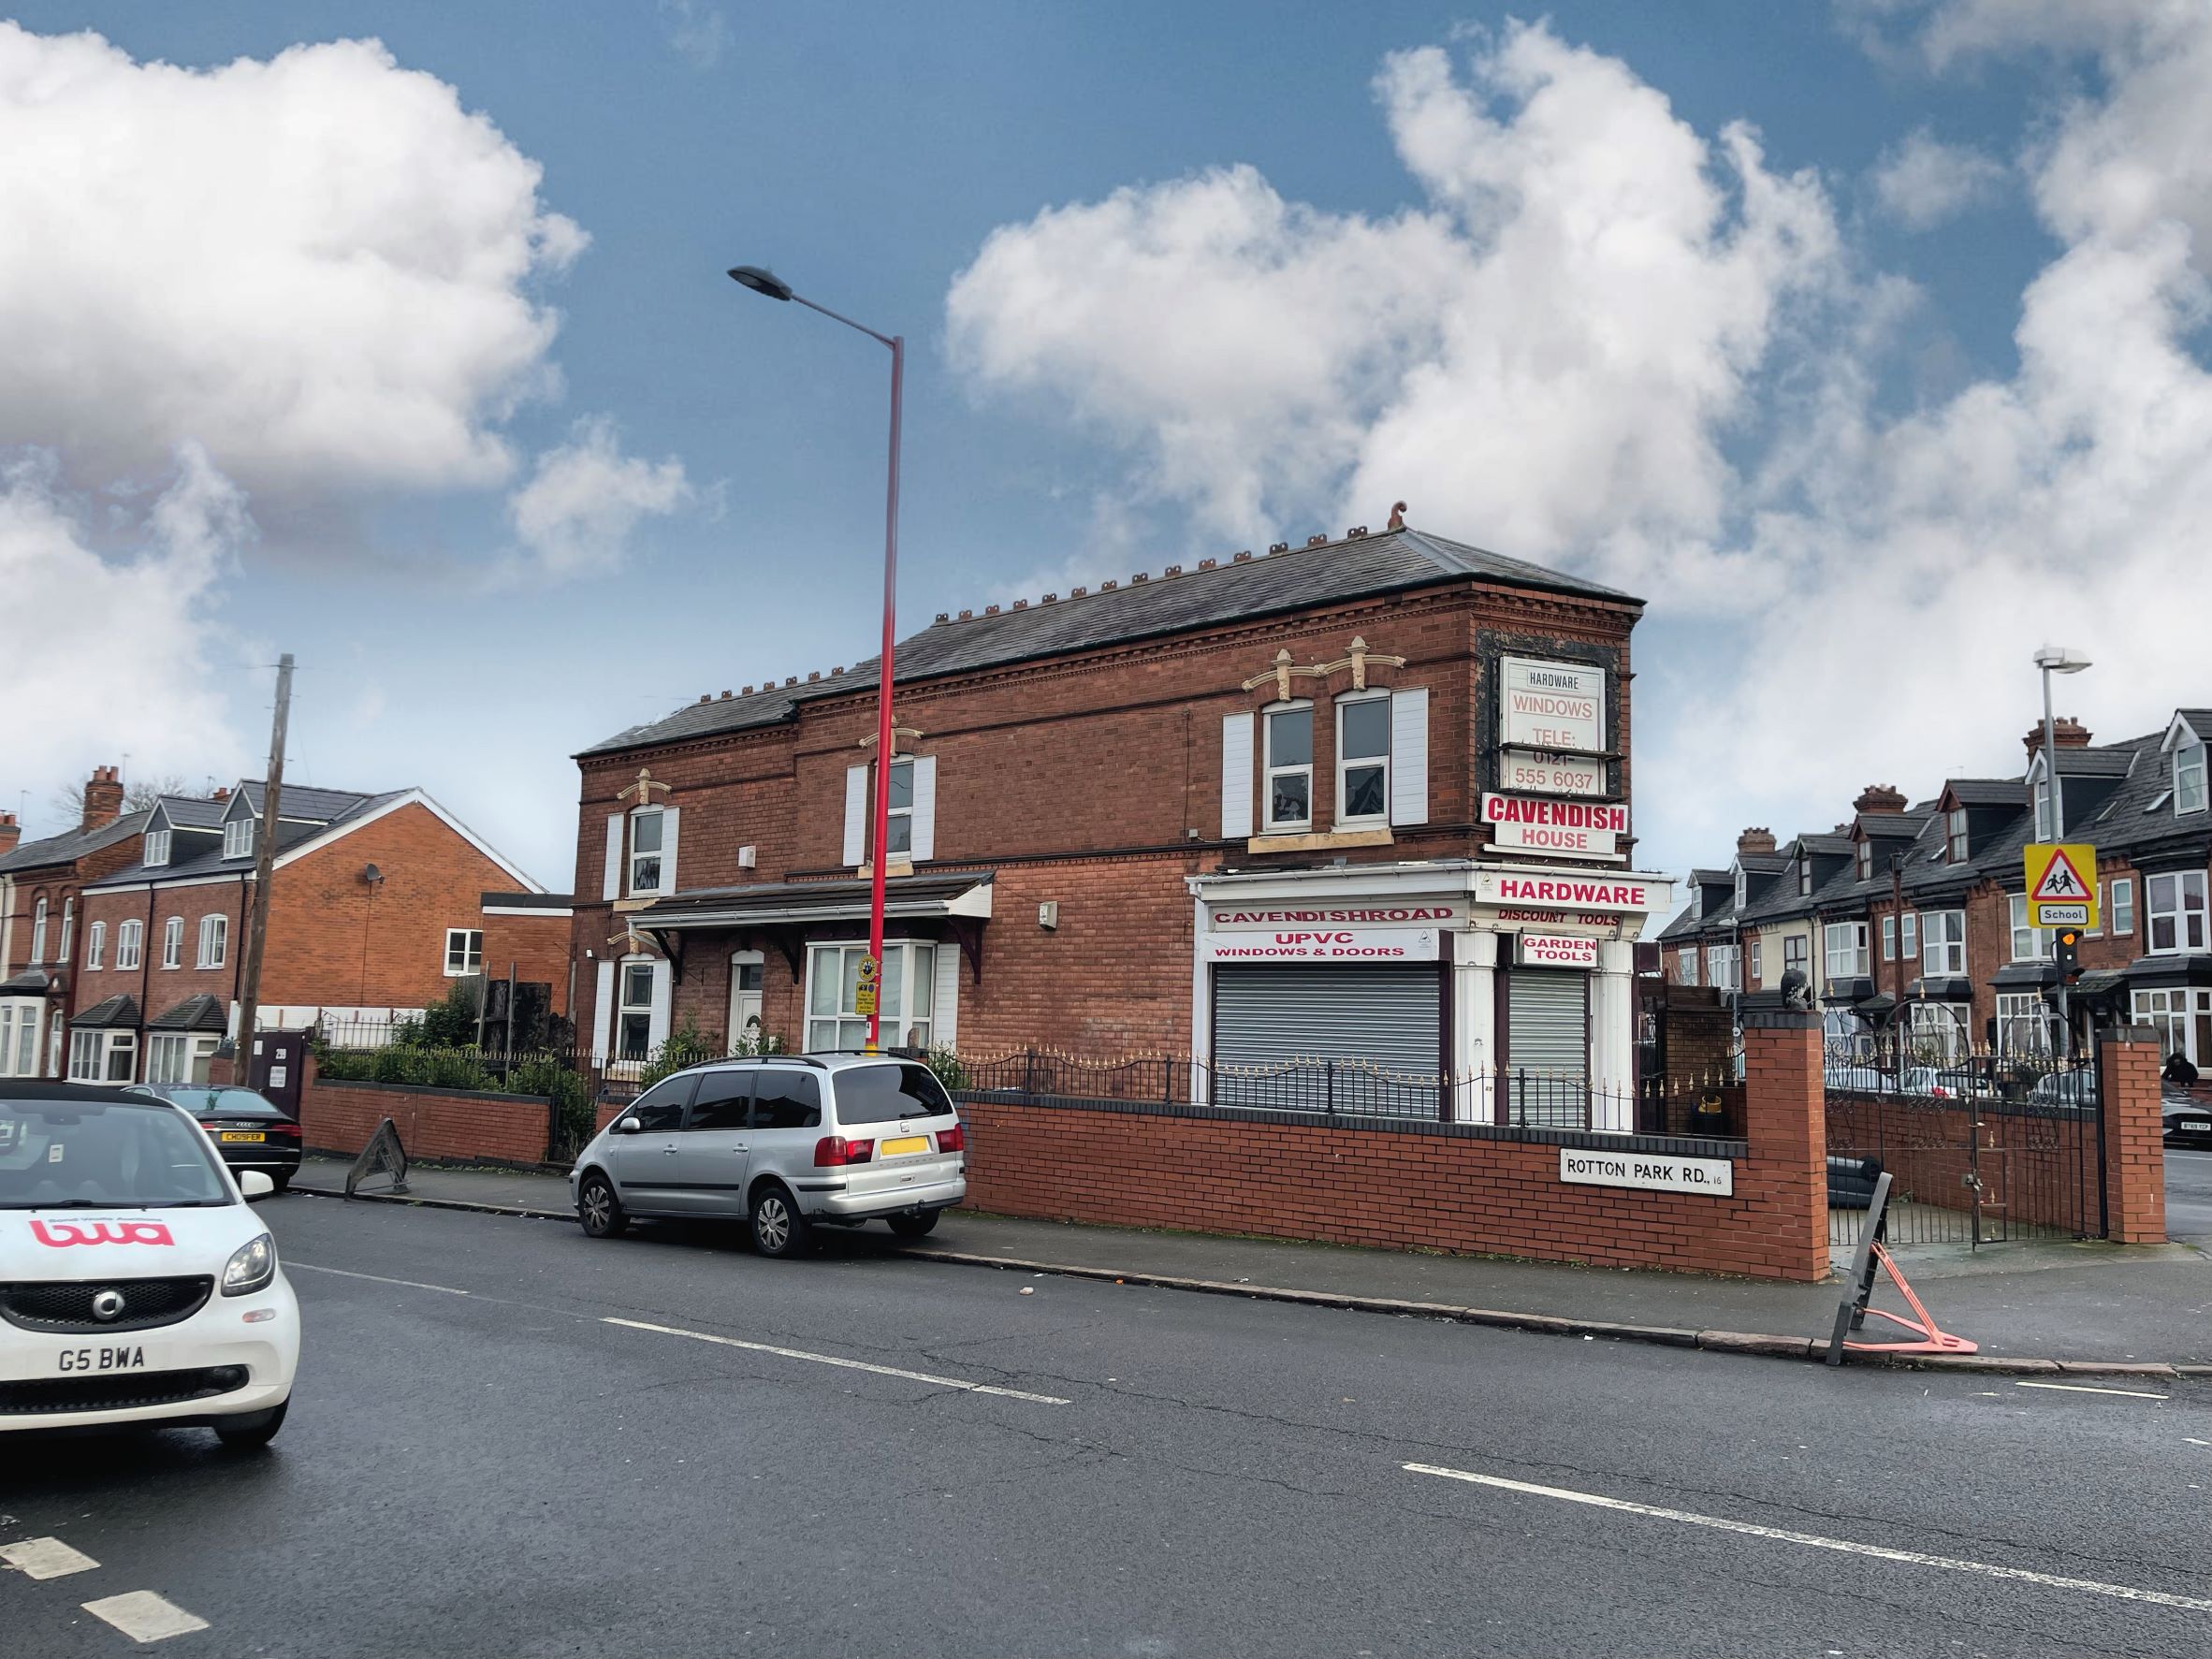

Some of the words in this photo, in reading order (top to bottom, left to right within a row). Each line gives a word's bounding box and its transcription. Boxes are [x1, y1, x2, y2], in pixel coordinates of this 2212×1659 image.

[1530, 672, 1579, 690] HARDWARE
[1513, 694, 1593, 719] WINDOWS
[1532, 727, 1577, 747] TELE:
[1516, 767, 1546, 785] 555
[1553, 770, 1594, 789] 6037
[1488, 796, 1625, 832] CAVENDISH
[1521, 828, 1588, 850] HOUSE
[1500, 880, 1646, 906] HARDWARE
[1497, 909, 1568, 924] DISCOUNT
[1578, 913, 1621, 926] TOOLS
[2044, 910, 2083, 919] School
[1274, 932, 1355, 945] UPVC
[1523, 938, 1596, 951] GARDEN
[1215, 948, 1308, 956] WINDOWS
[1312, 948, 1327, 956] &
[1332, 947, 1404, 956] DOORS
[1534, 949, 1594, 962] TOOLS
[1567, 1158, 1625, 1177] ROTTON
[1634, 1163, 1674, 1181] PARK
[28, 1220, 176, 1248] bwa
[59, 1349, 91, 1372] G5
[98, 1346, 144, 1370] BWA
